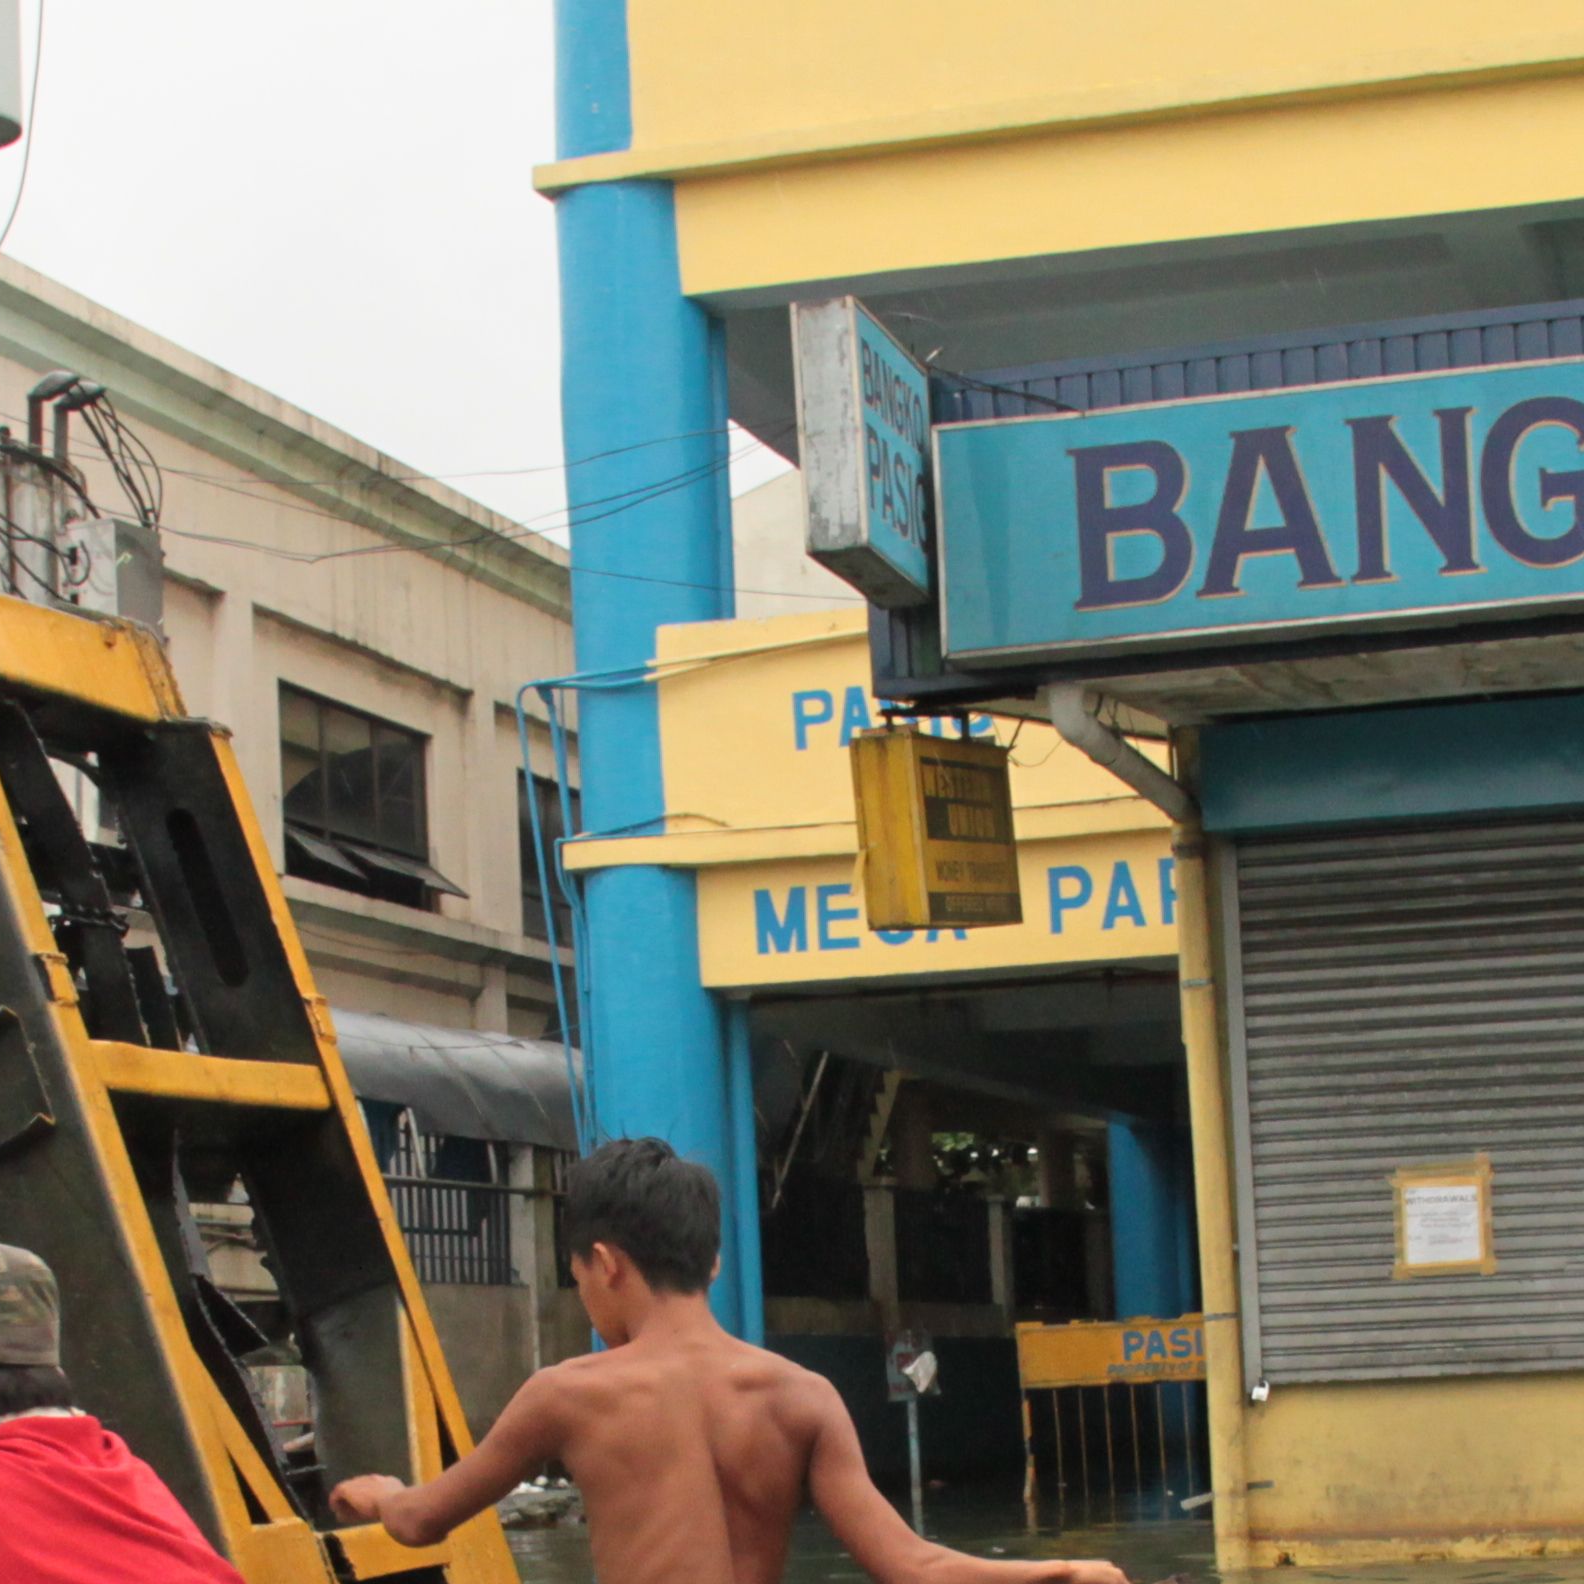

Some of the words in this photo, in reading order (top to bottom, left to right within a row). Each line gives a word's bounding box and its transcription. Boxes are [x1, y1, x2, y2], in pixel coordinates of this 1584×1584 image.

[861, 336, 925, 454] BANGKO
[866, 421, 929, 555] PASIG
[754, 884, 967, 955] ME
